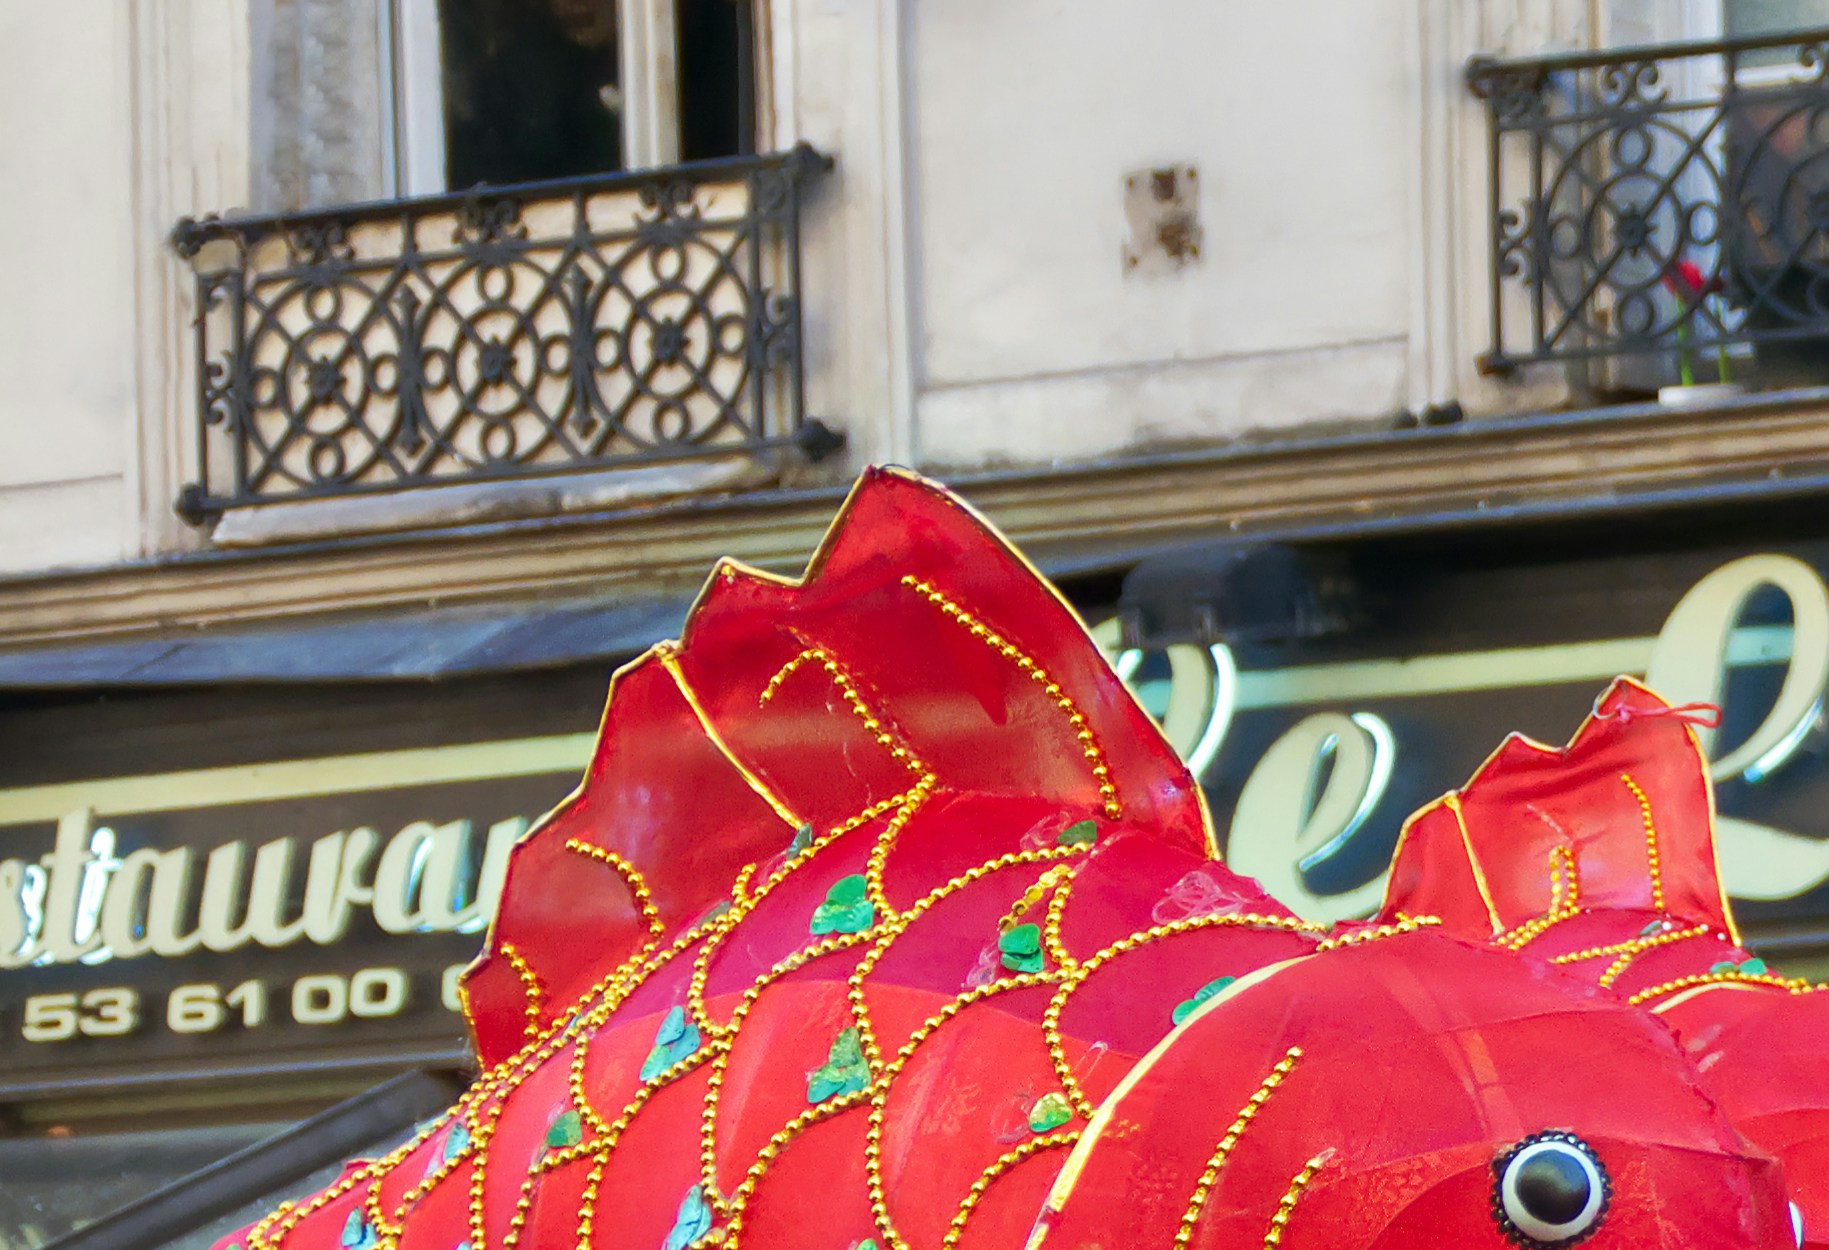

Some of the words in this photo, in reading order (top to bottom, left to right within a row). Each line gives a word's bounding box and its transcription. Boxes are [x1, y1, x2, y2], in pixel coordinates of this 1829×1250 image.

[21, 986, 140, 1042] 53
[166, 979, 267, 1033] 61
[291, 966, 408, 1024] 00
